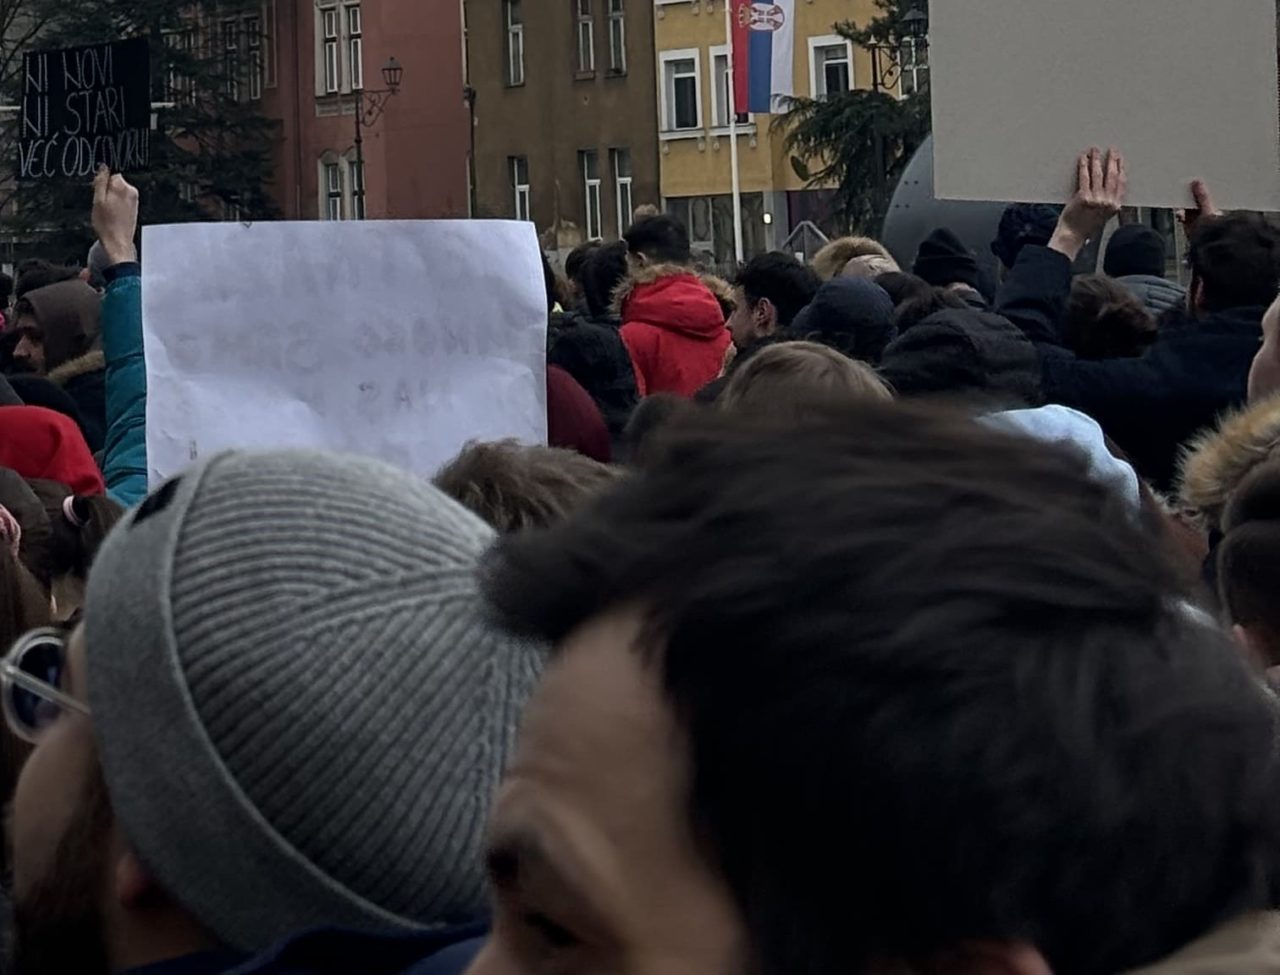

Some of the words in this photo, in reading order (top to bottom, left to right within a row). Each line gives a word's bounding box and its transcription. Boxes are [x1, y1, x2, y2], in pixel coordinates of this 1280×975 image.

[24, 53, 49, 94] NI
[61, 44, 114, 91] NOVI
[22, 94, 49, 138] NI
[63, 85, 126, 135] STARI
[19, 131, 60, 178] VEĆ
